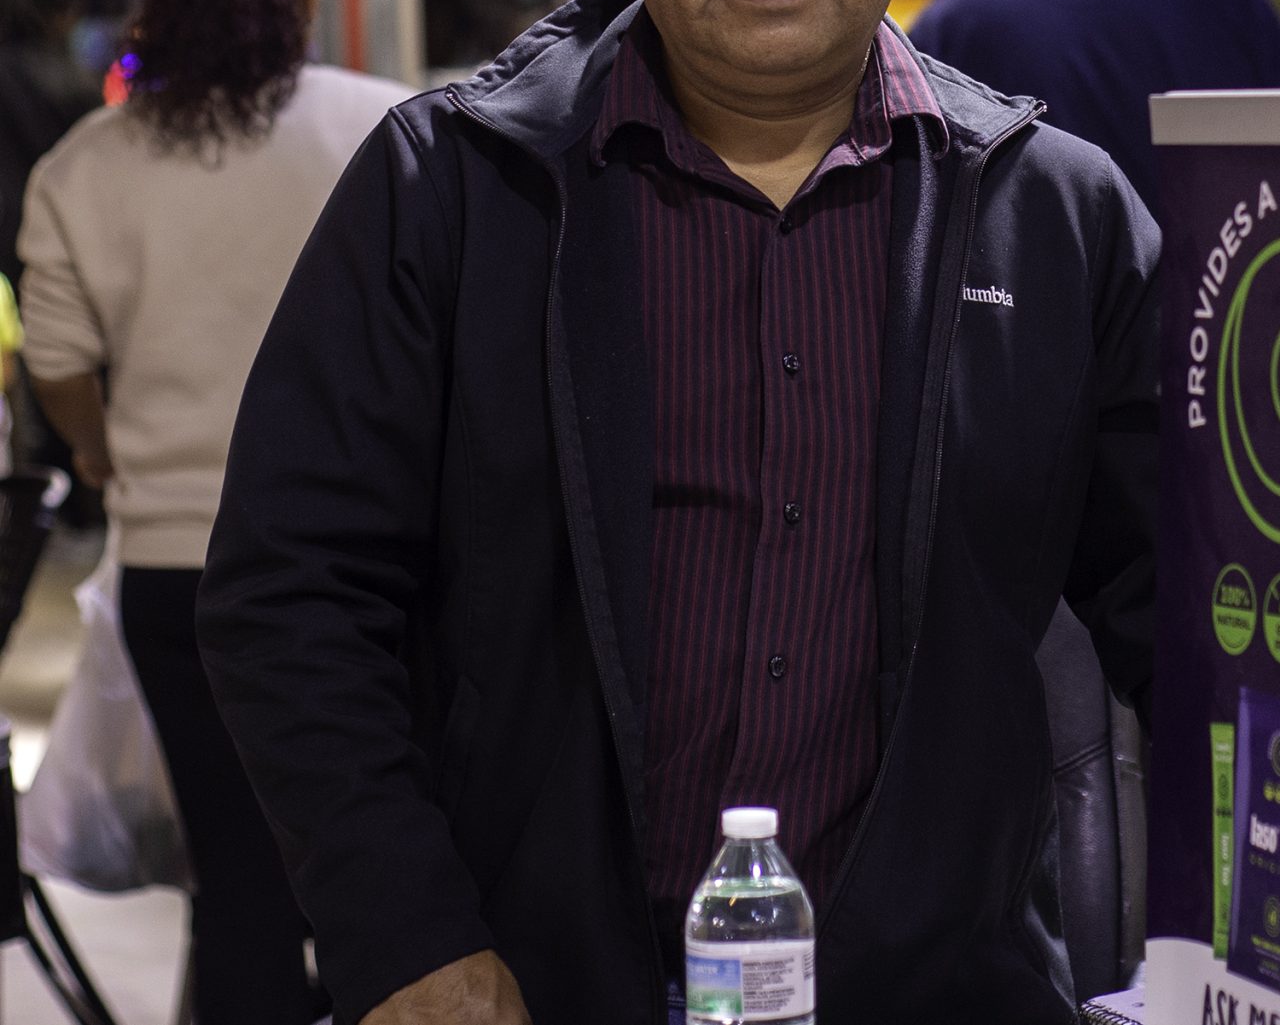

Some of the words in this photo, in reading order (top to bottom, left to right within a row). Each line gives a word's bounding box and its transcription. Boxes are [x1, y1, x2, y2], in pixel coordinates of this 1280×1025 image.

[1187, 202, 1252, 428] PROVIDES
[1258, 180, 1277, 219] A
[1202, 984, 1239, 1025] ASK
